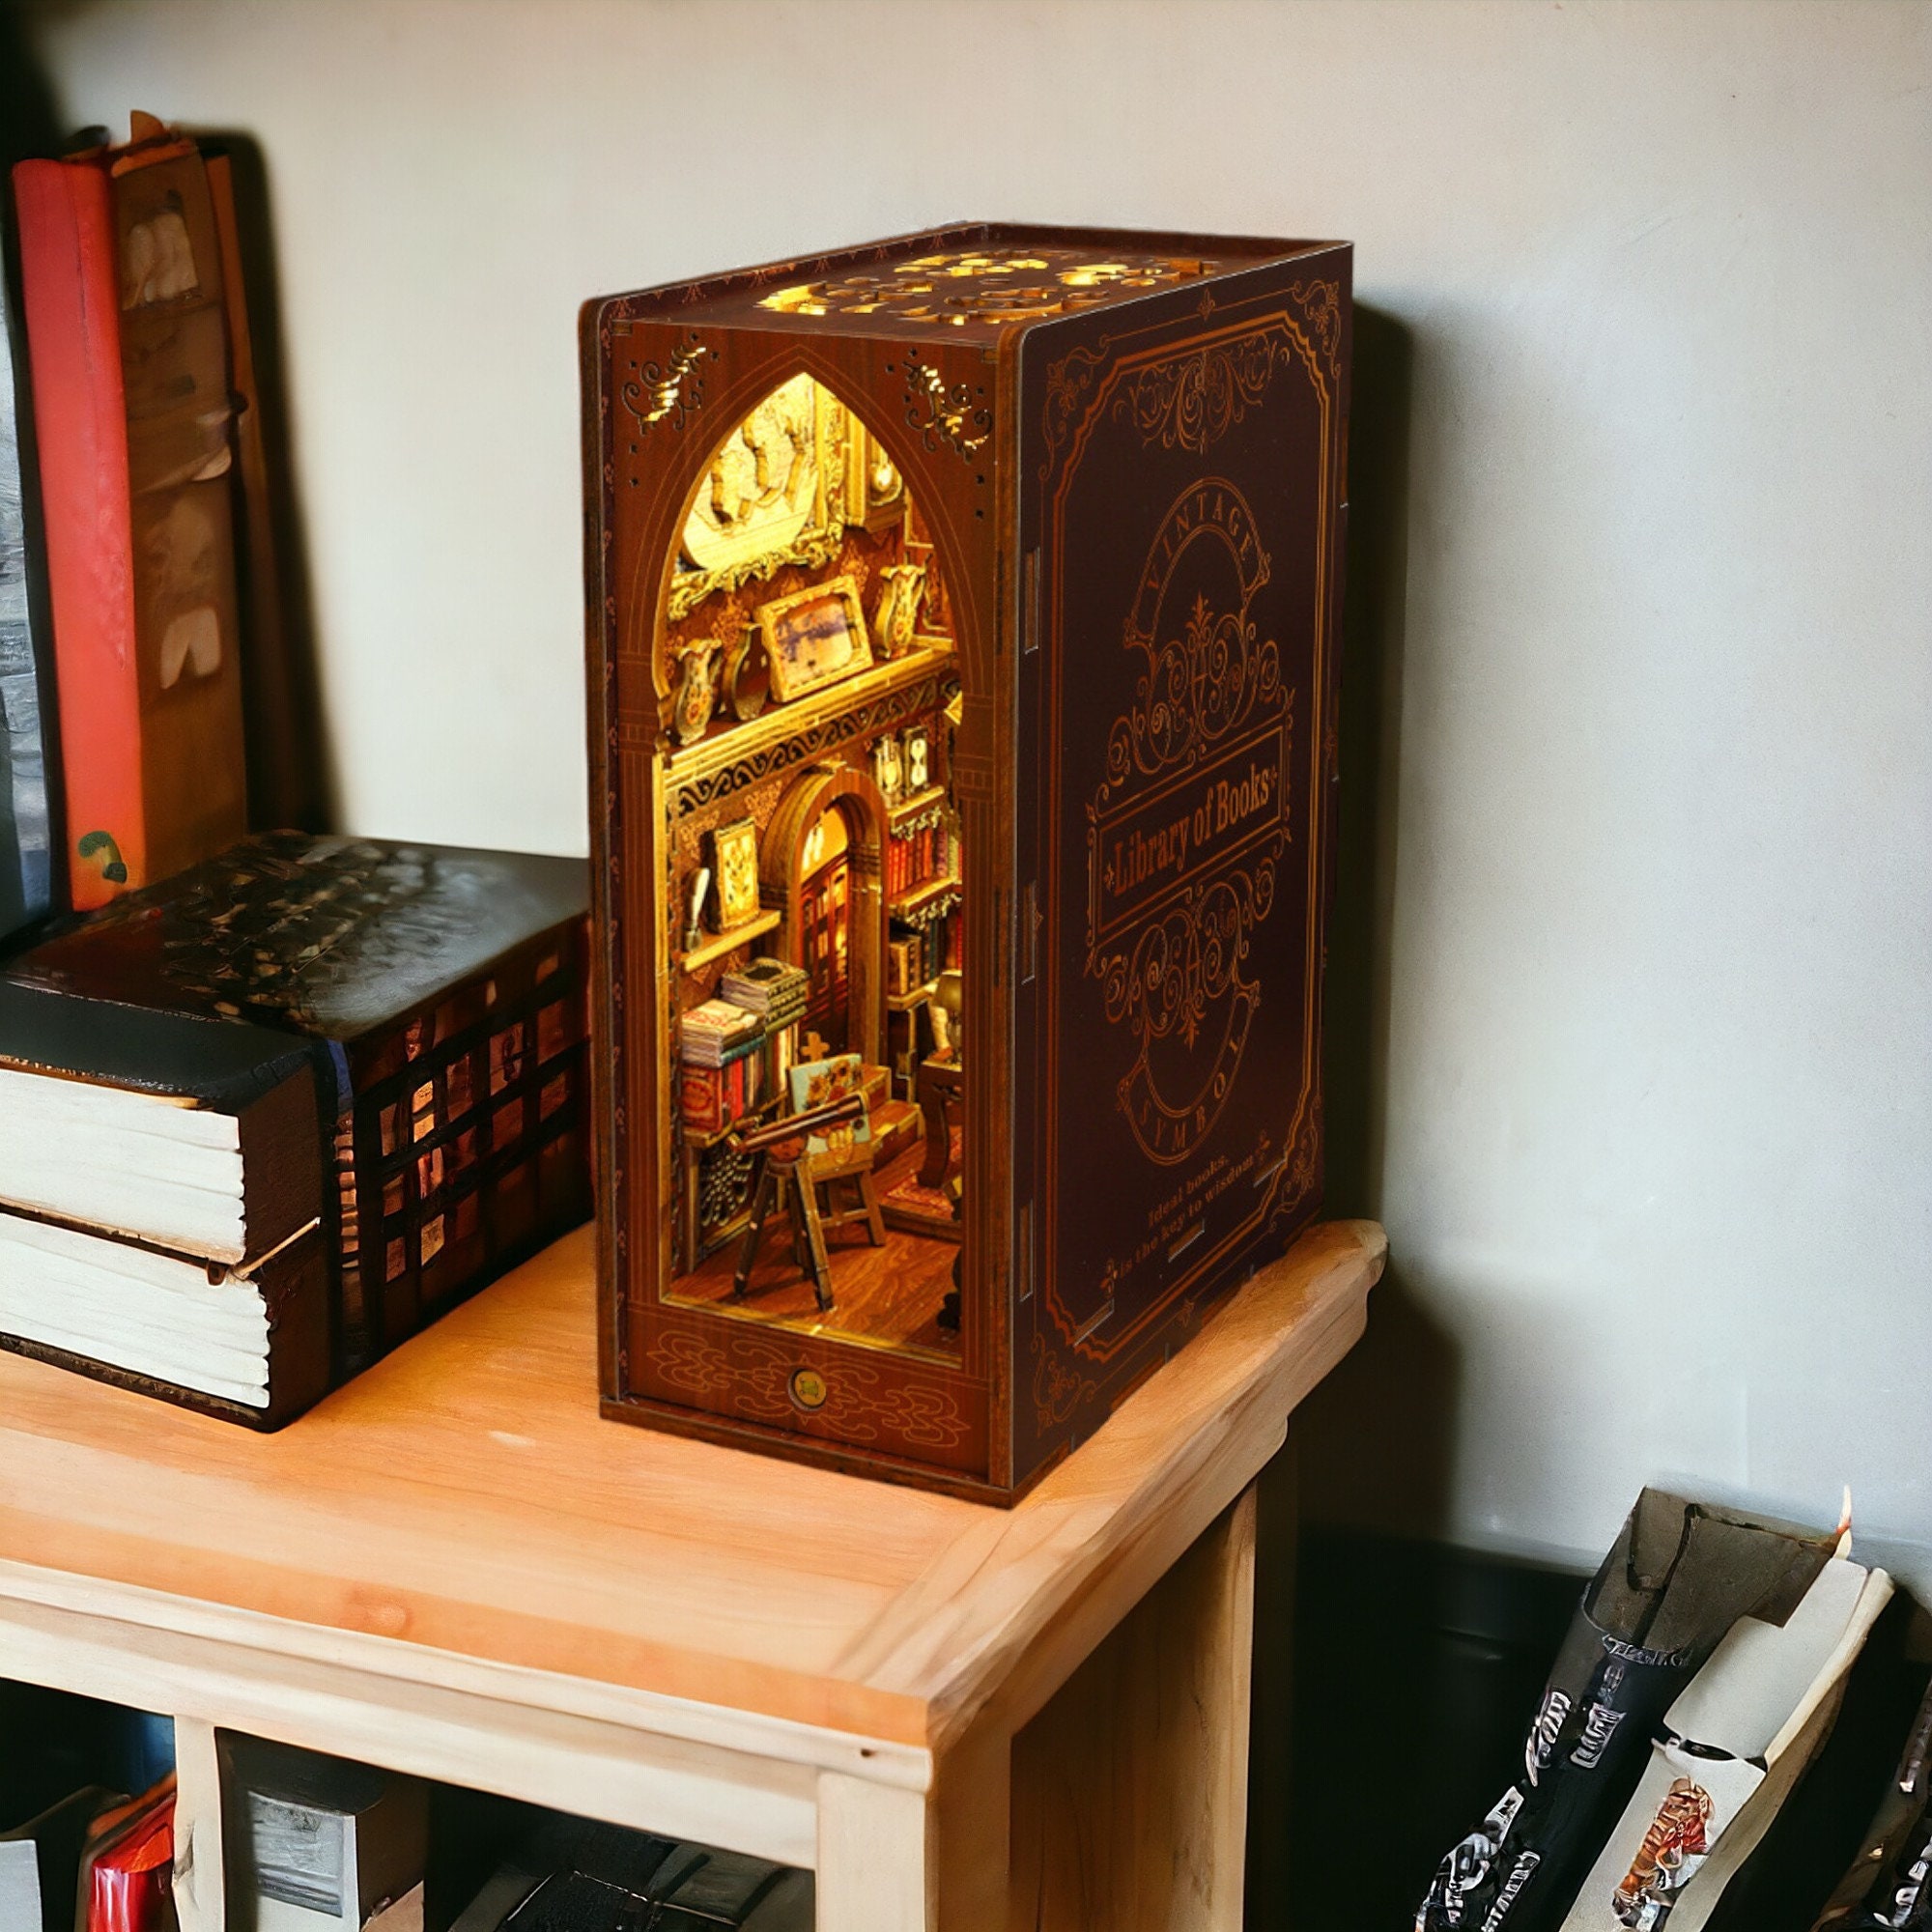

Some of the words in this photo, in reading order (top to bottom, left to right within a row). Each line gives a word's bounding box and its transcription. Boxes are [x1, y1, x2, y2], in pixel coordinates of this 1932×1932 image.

[1114, 815, 1190, 895] Library
[1193, 787, 1213, 846] of
[1216, 763, 1268, 833] Books
[1188, 1199, 1203, 1217] to
